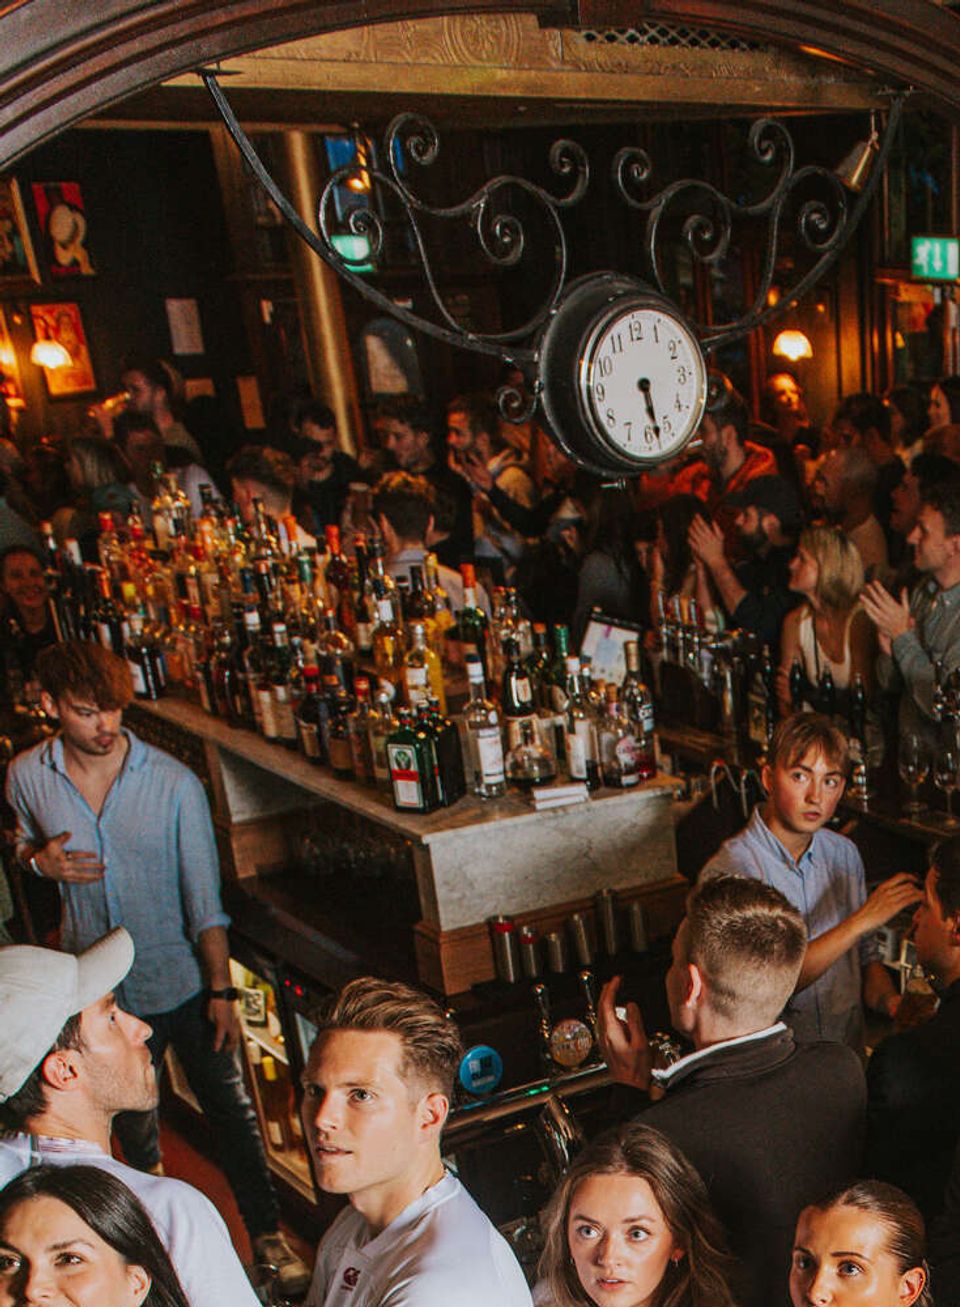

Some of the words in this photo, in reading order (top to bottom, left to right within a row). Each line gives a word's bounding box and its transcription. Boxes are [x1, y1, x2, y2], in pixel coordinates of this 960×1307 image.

[628, 320, 643, 341] 12
[653, 323, 659, 344] 1
[610, 334, 623, 354] 11
[667, 339, 677, 360] 2
[598, 355, 613, 377] 10
[677, 366, 687, 385] 3
[595, 382, 605, 403] 9
[674, 392, 682, 413] 4
[606, 407, 616, 428] 8
[661, 414, 672, 434] 5
[623, 421, 633, 442] 7
[644, 423, 655, 445] 6
